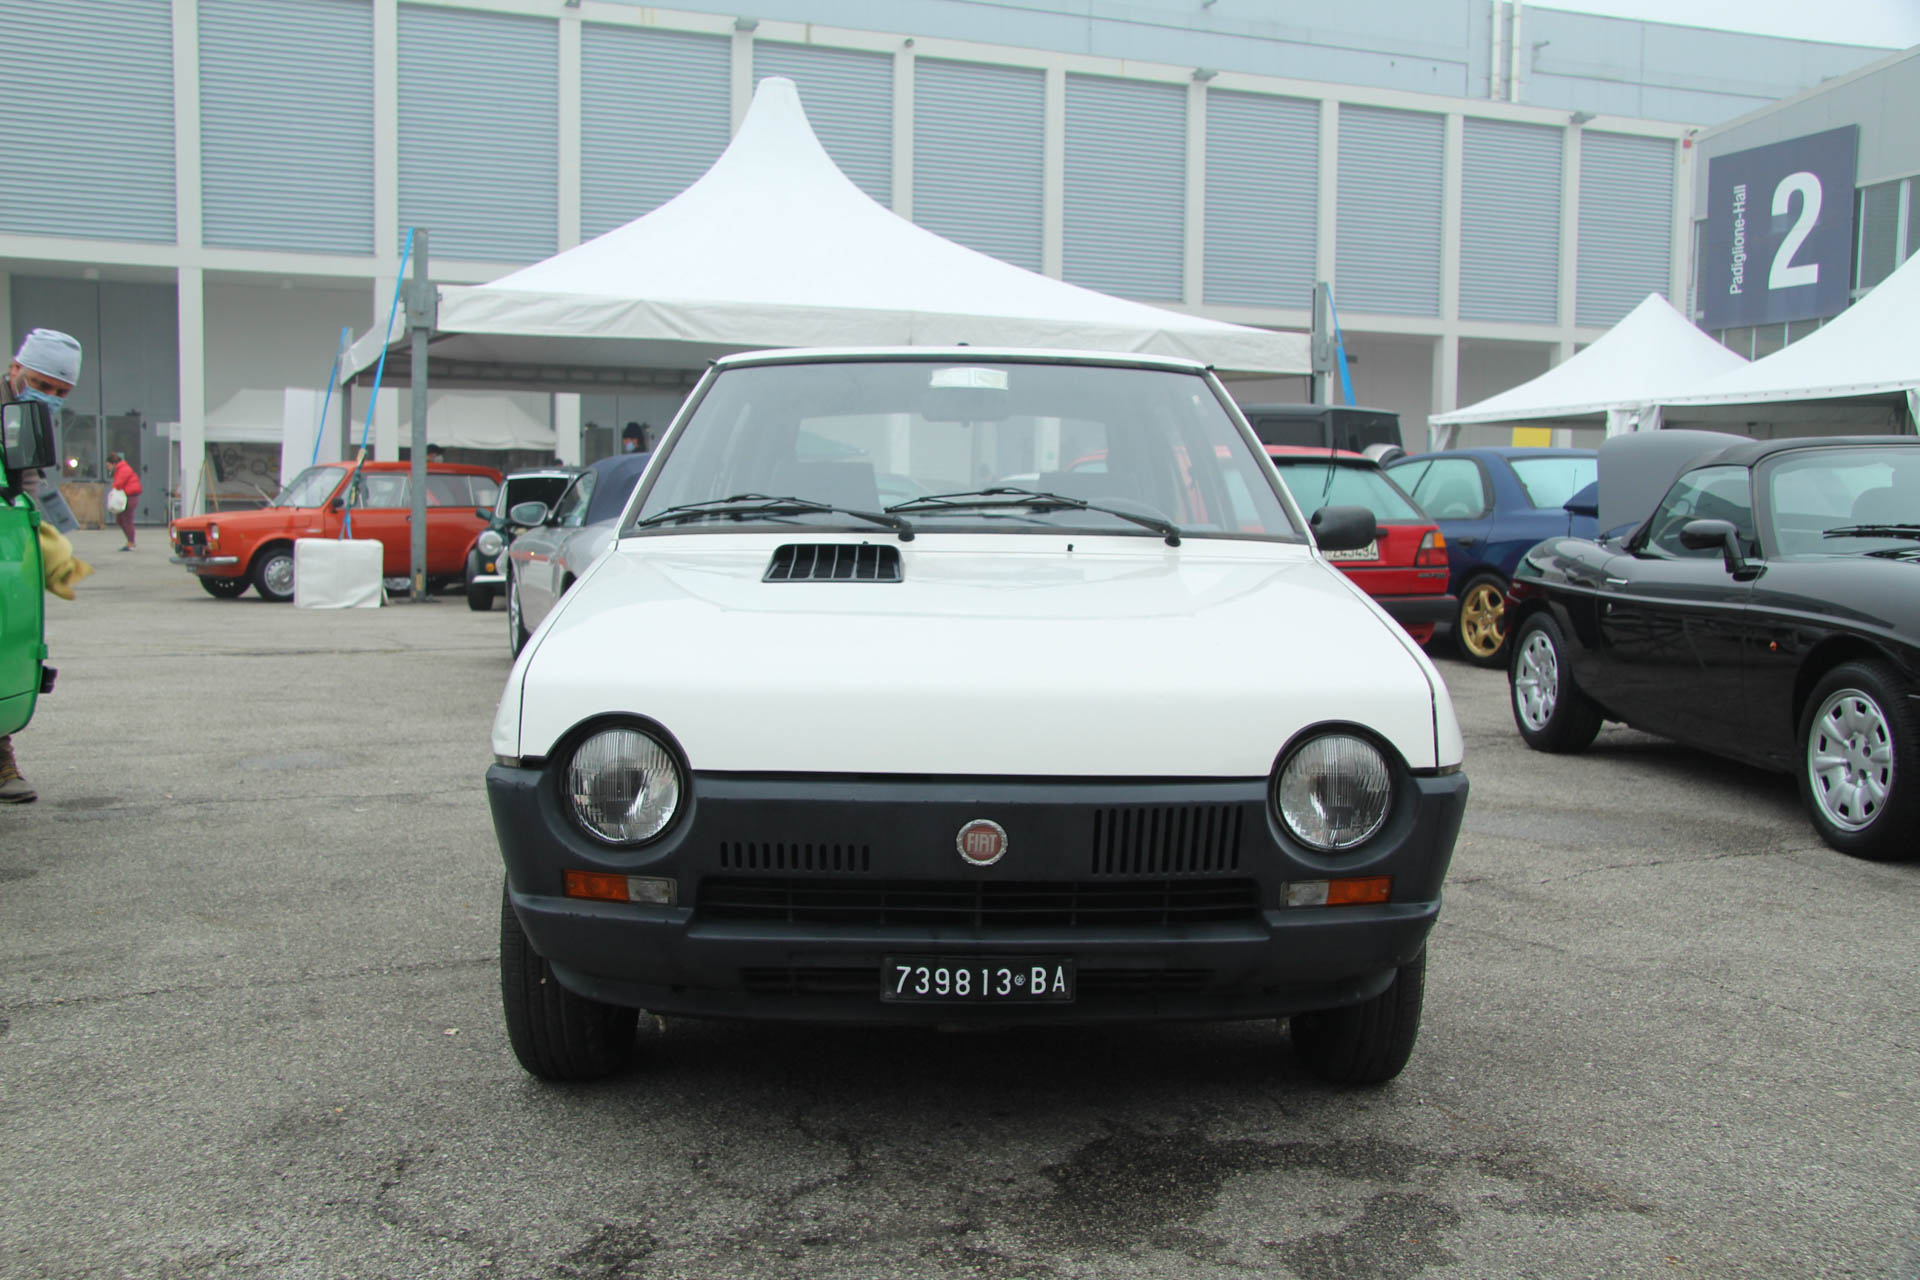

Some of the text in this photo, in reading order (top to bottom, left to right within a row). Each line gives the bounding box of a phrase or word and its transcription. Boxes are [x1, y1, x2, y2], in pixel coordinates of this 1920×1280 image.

[1729, 184, 1747, 294] Padiglione-Hall
[1768, 171, 1823, 290] 2
[967, 832, 998, 854] FIAT
[1031, 966, 1065, 995] BA
